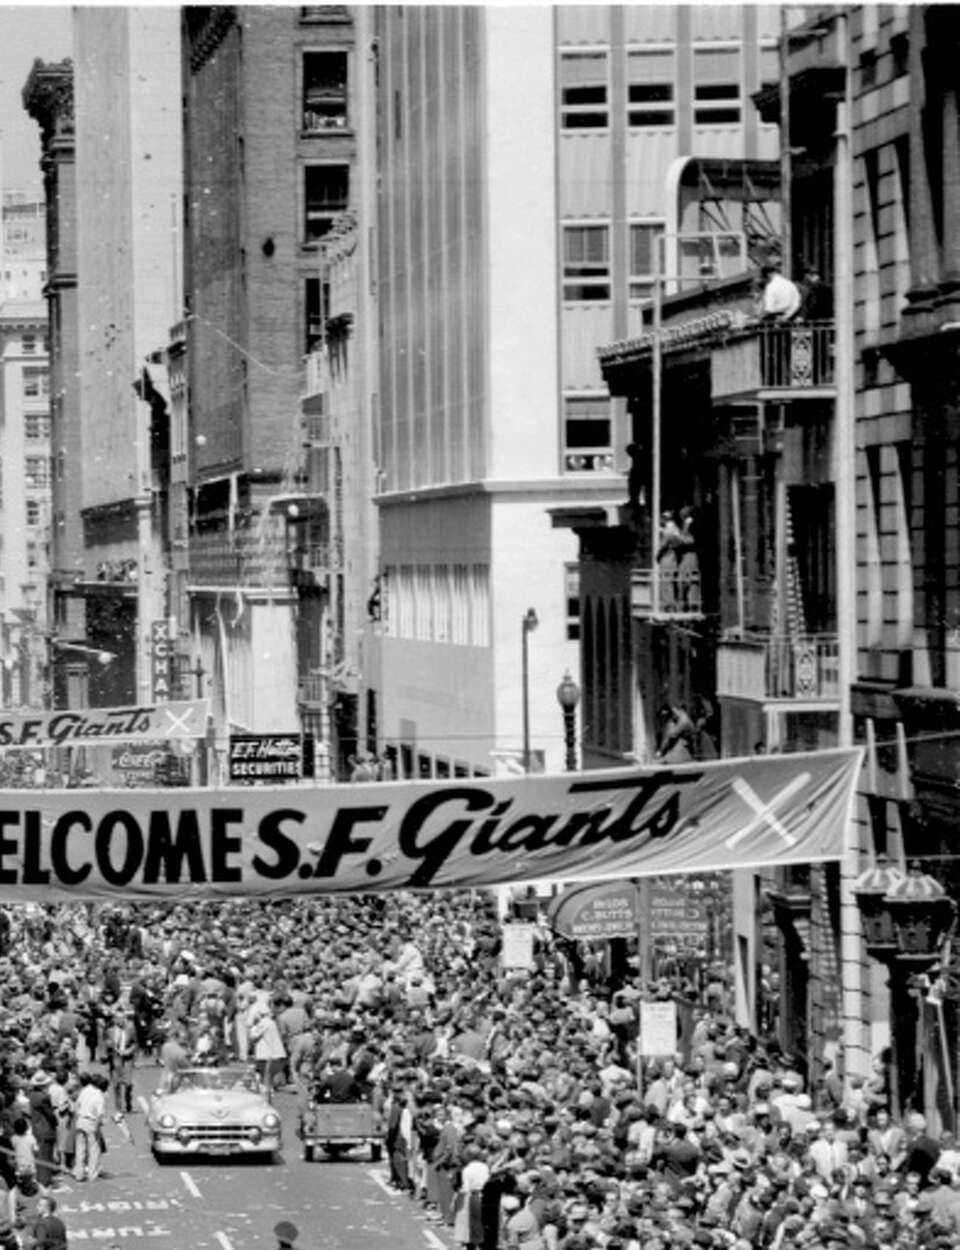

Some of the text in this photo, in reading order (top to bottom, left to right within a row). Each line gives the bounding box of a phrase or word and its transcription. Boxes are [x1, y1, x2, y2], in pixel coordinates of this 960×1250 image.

[47, 707, 157, 746] Giants
[251, 804, 390, 880] S.F.
[397, 771, 705, 888] Giants
